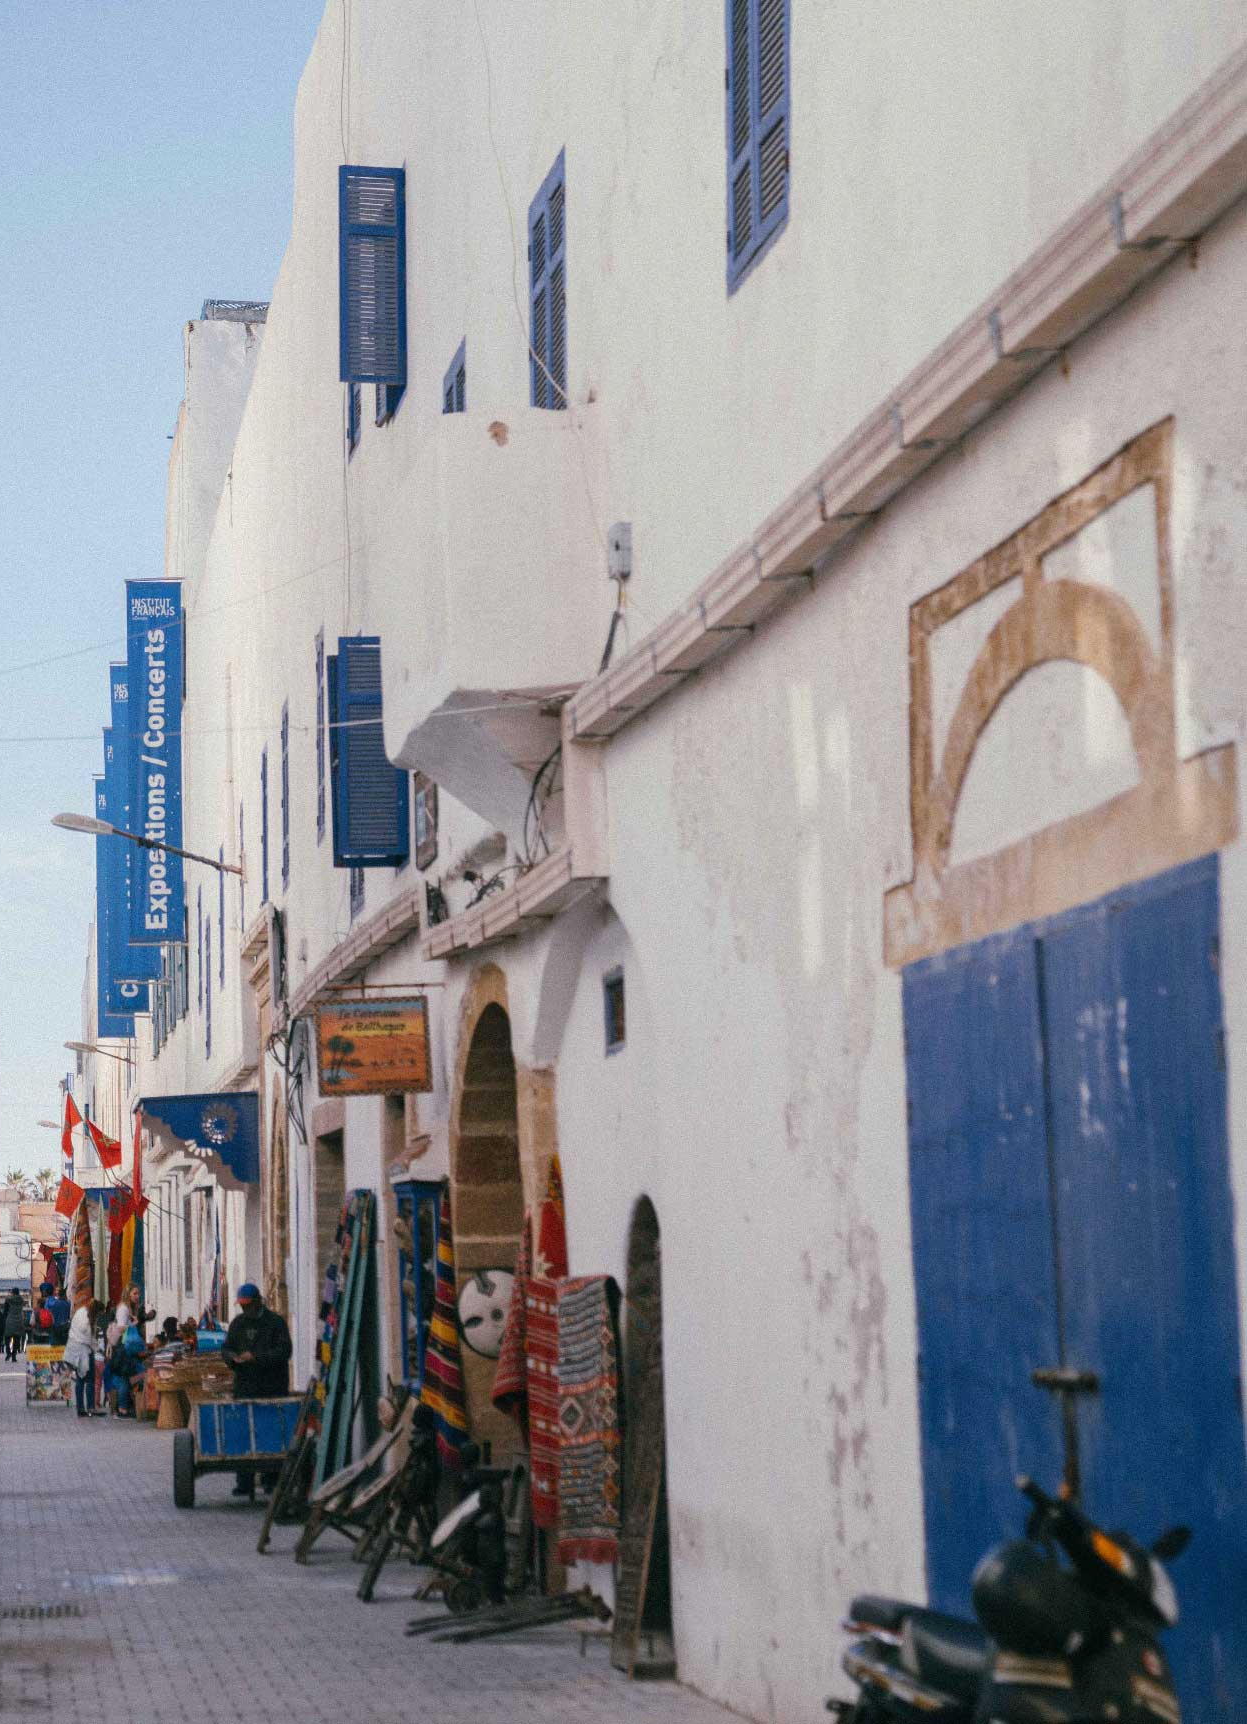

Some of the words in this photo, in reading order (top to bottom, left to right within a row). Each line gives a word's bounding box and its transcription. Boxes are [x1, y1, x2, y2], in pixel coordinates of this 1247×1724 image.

[131, 598, 171, 608] INSTITUT
[144, 630, 165, 748] Concerts
[145, 774, 171, 929] Expostions
